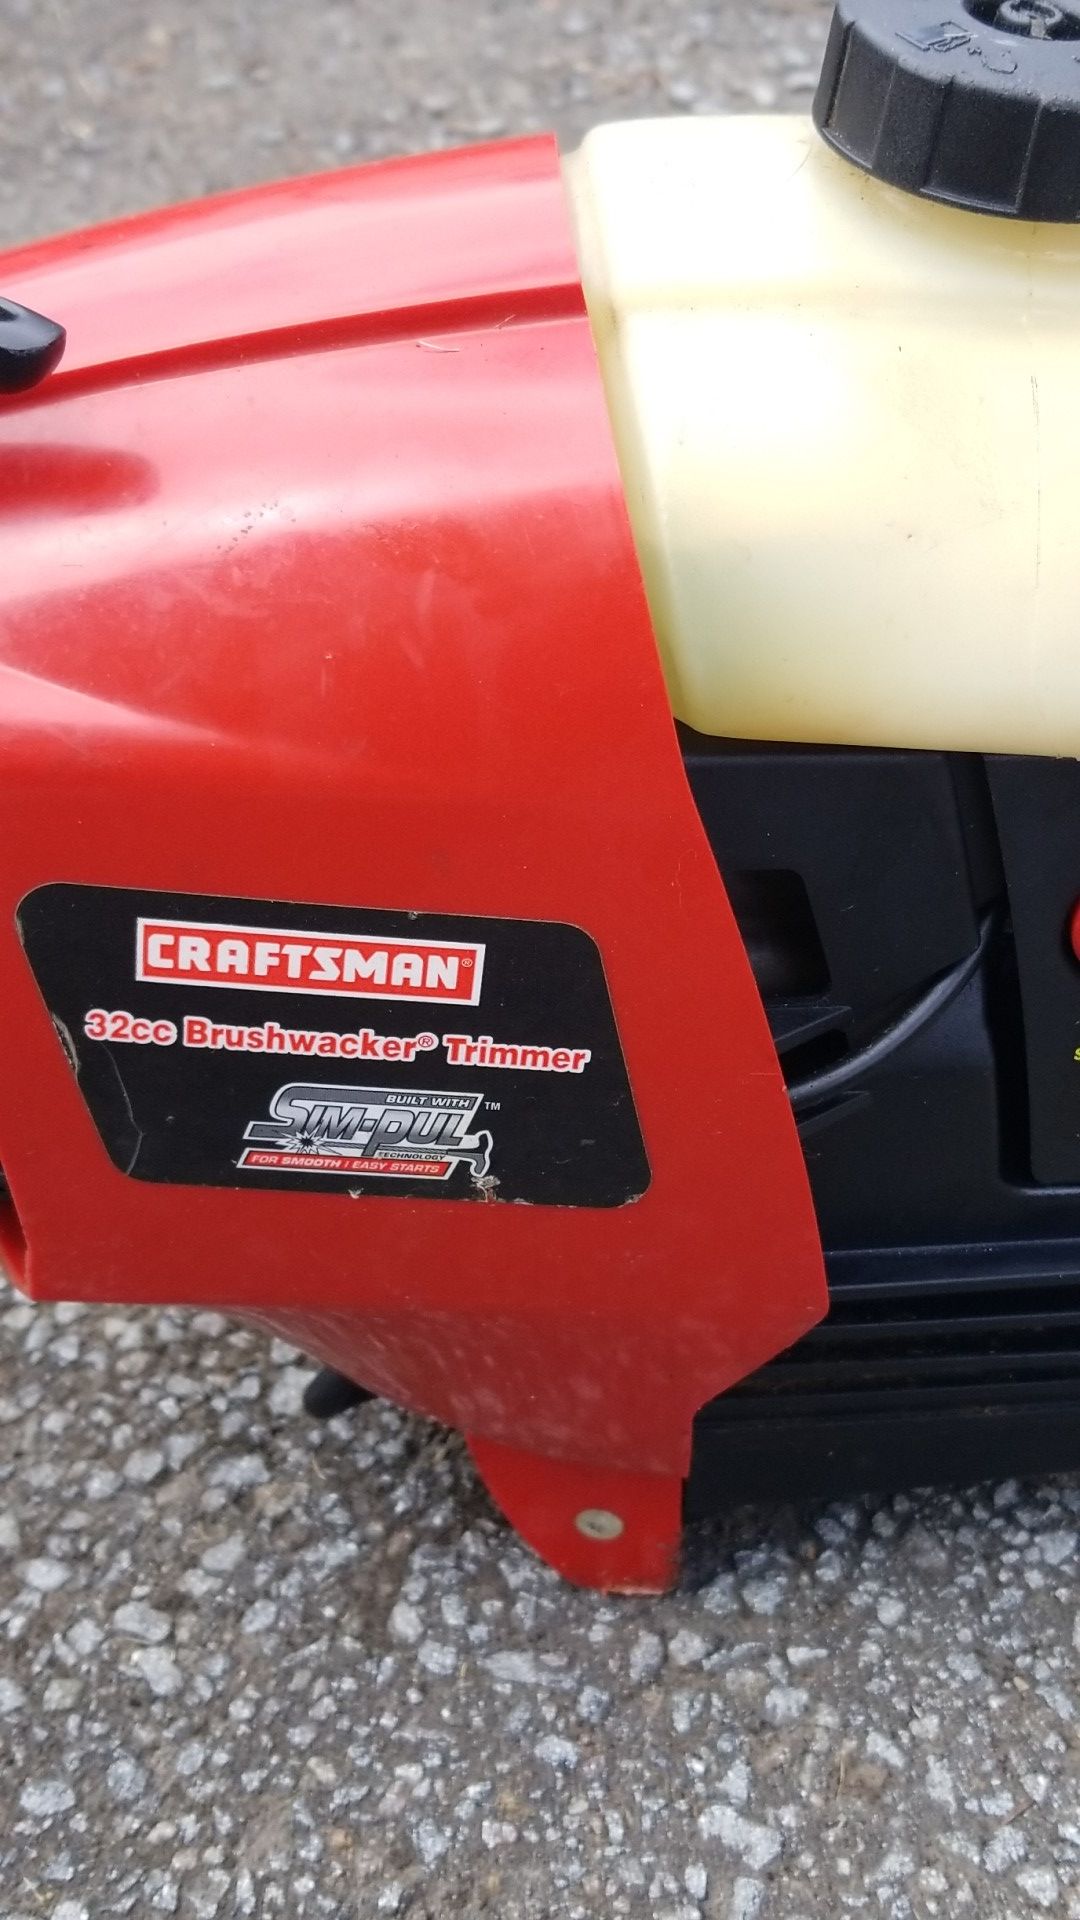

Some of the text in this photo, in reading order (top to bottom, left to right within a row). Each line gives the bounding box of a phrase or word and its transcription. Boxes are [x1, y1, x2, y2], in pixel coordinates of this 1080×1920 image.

[84, 1008, 177, 1046] 32cc
[442, 1034, 592, 1073] Trimmer
[385, 1094, 471, 1109] BUILT WITH
[250, 1154, 279, 1165] FOR
[281, 1156, 341, 1169] SMOOTH
[352, 1160, 388, 1171] EASY
[389, 1162, 442, 1174] STARTS
[378, 1151, 446, 1163] TECHNOLOGY
